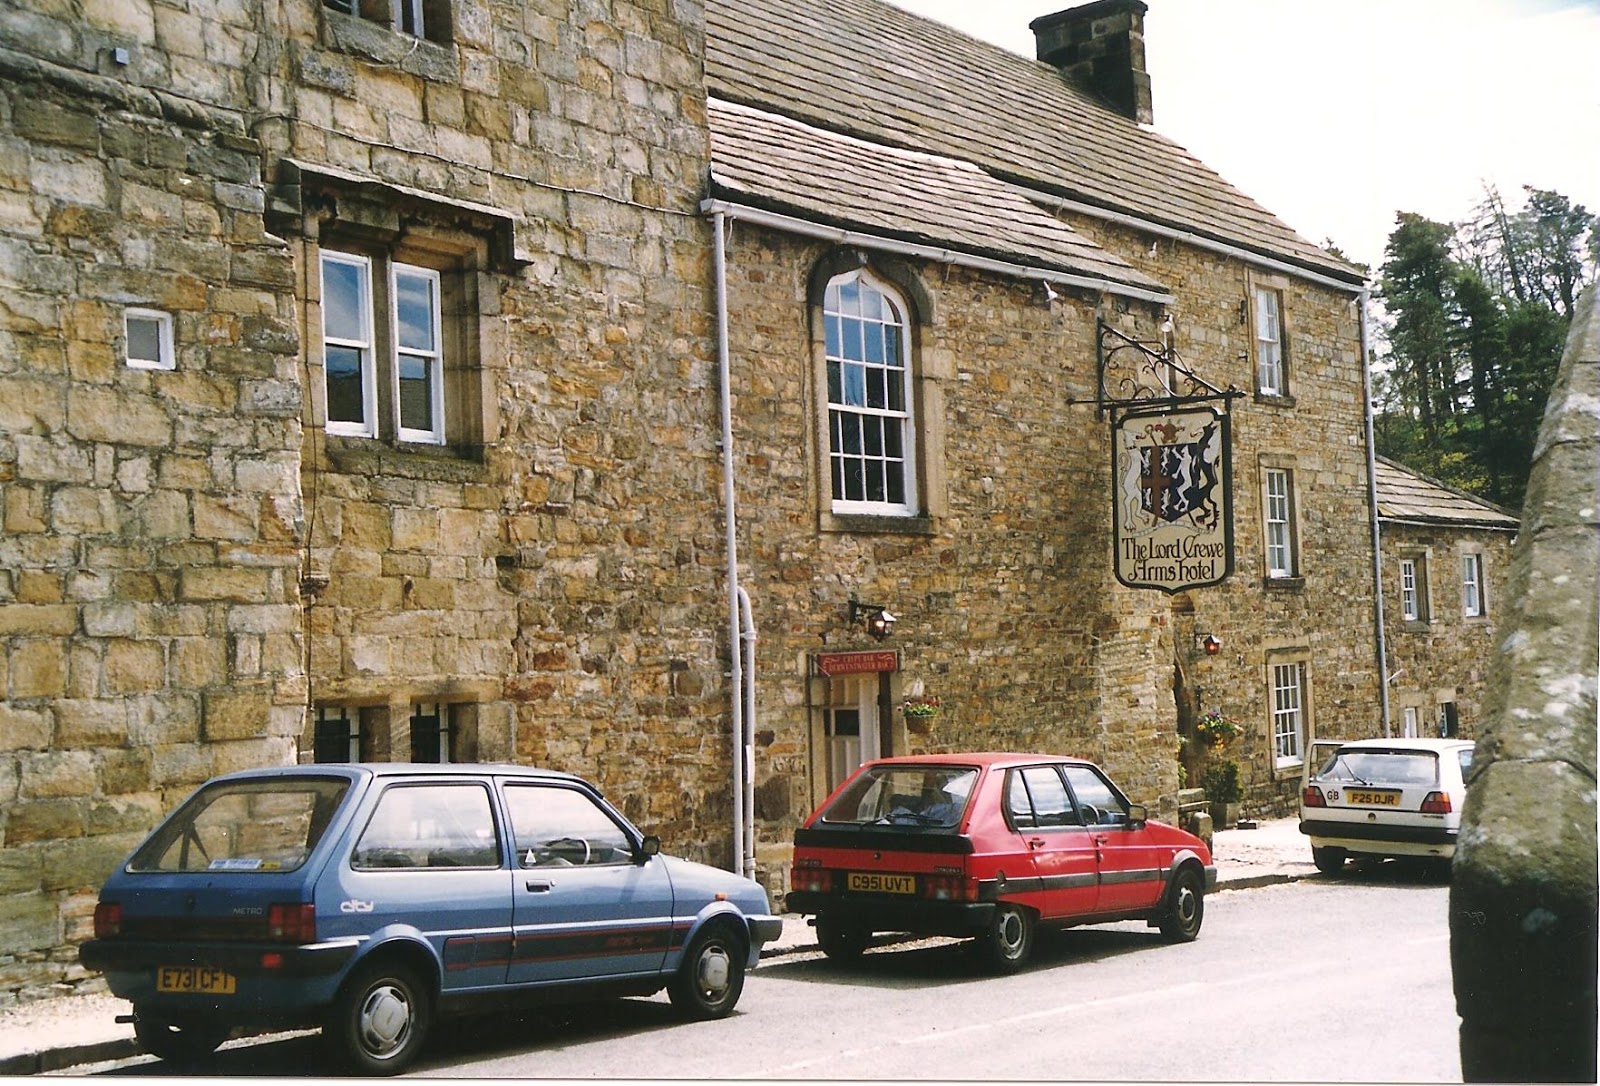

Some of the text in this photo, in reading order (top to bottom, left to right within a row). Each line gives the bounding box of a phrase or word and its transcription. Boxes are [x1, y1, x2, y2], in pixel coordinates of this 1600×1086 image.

[1122, 534, 1224, 560] The Lord Crewe
[1128, 559, 1176, 581] Arms
[1327, 790, 1339, 801] GB
[1352, 793, 1372, 804] F25
[852, 875, 911, 892] C951 UVT
[233, 907, 263, 915] METRO
[340, 899, 374, 913] city
[163, 968, 197, 989] E731
